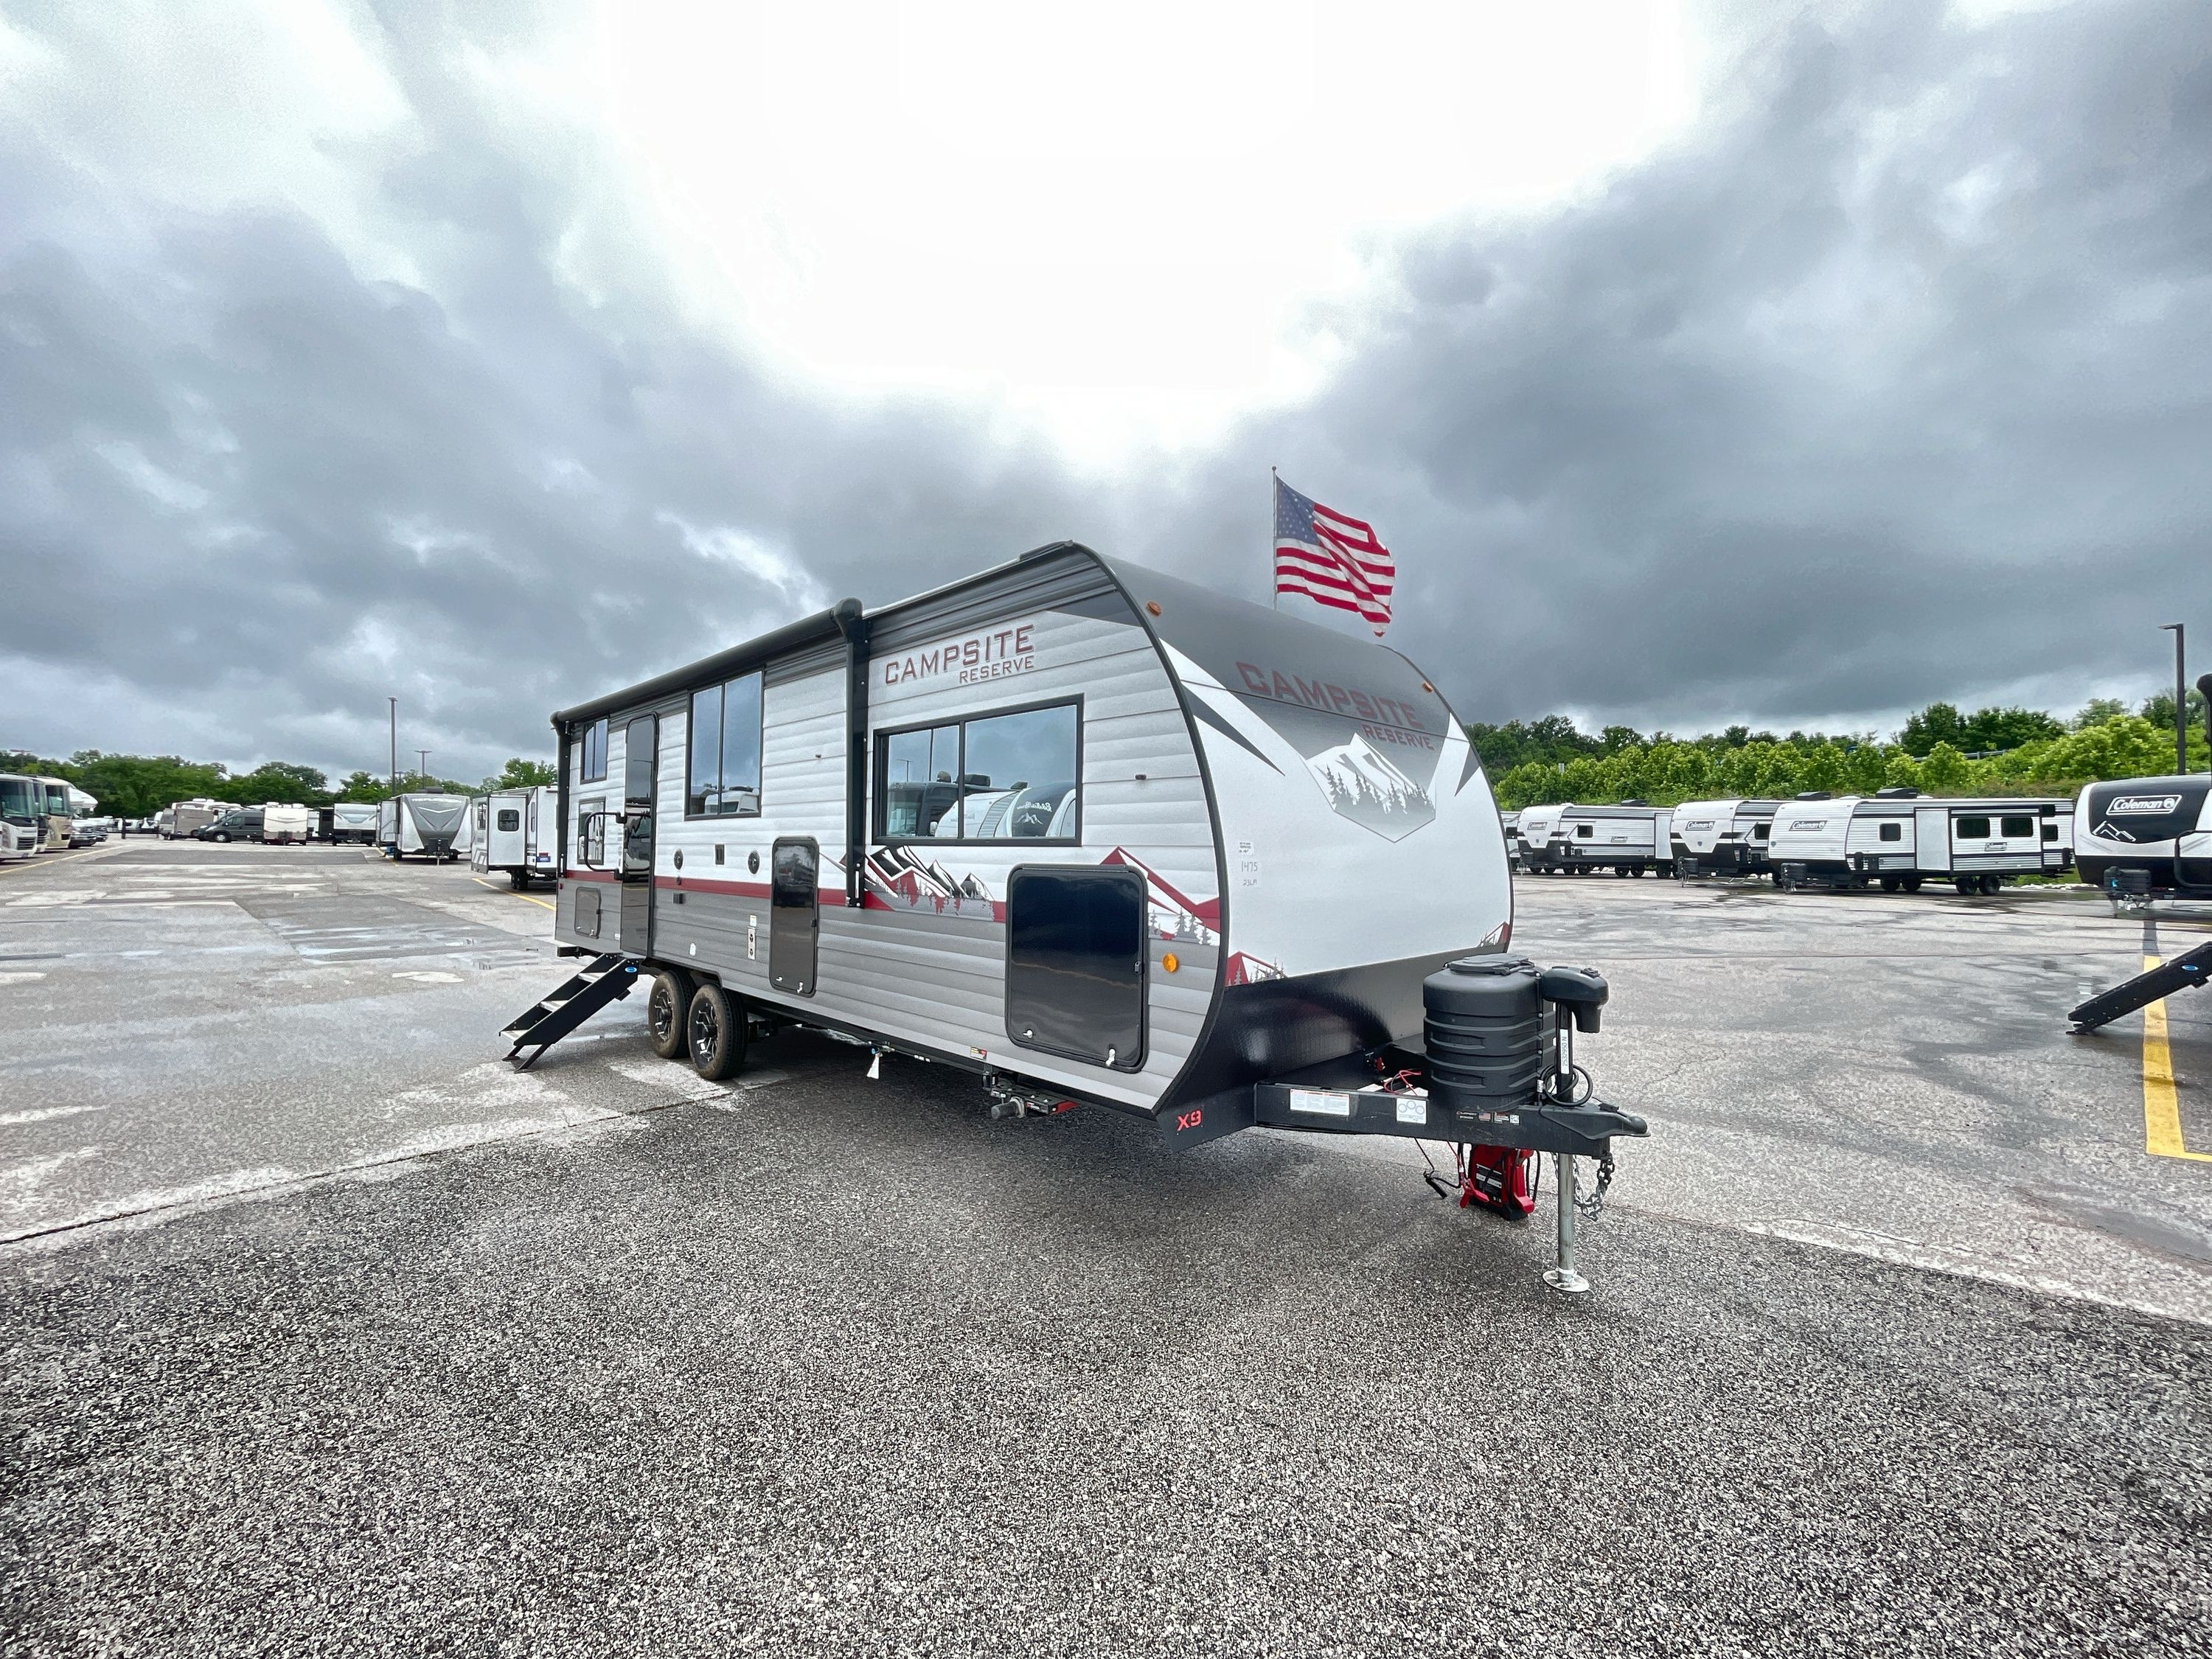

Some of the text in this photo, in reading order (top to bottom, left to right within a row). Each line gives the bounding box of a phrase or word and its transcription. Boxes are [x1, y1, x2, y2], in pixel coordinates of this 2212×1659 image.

[885, 624, 1035, 685] CAMPSITE
[959, 655, 1034, 684] RESERVE
[1234, 661, 1426, 730] CAMPSITE
[1362, 723, 1435, 751] RESERVE
[2113, 799, 2163, 810] Coleman
[1241, 860, 1258, 872] 1475
[1176, 1110, 1202, 1131] X9
